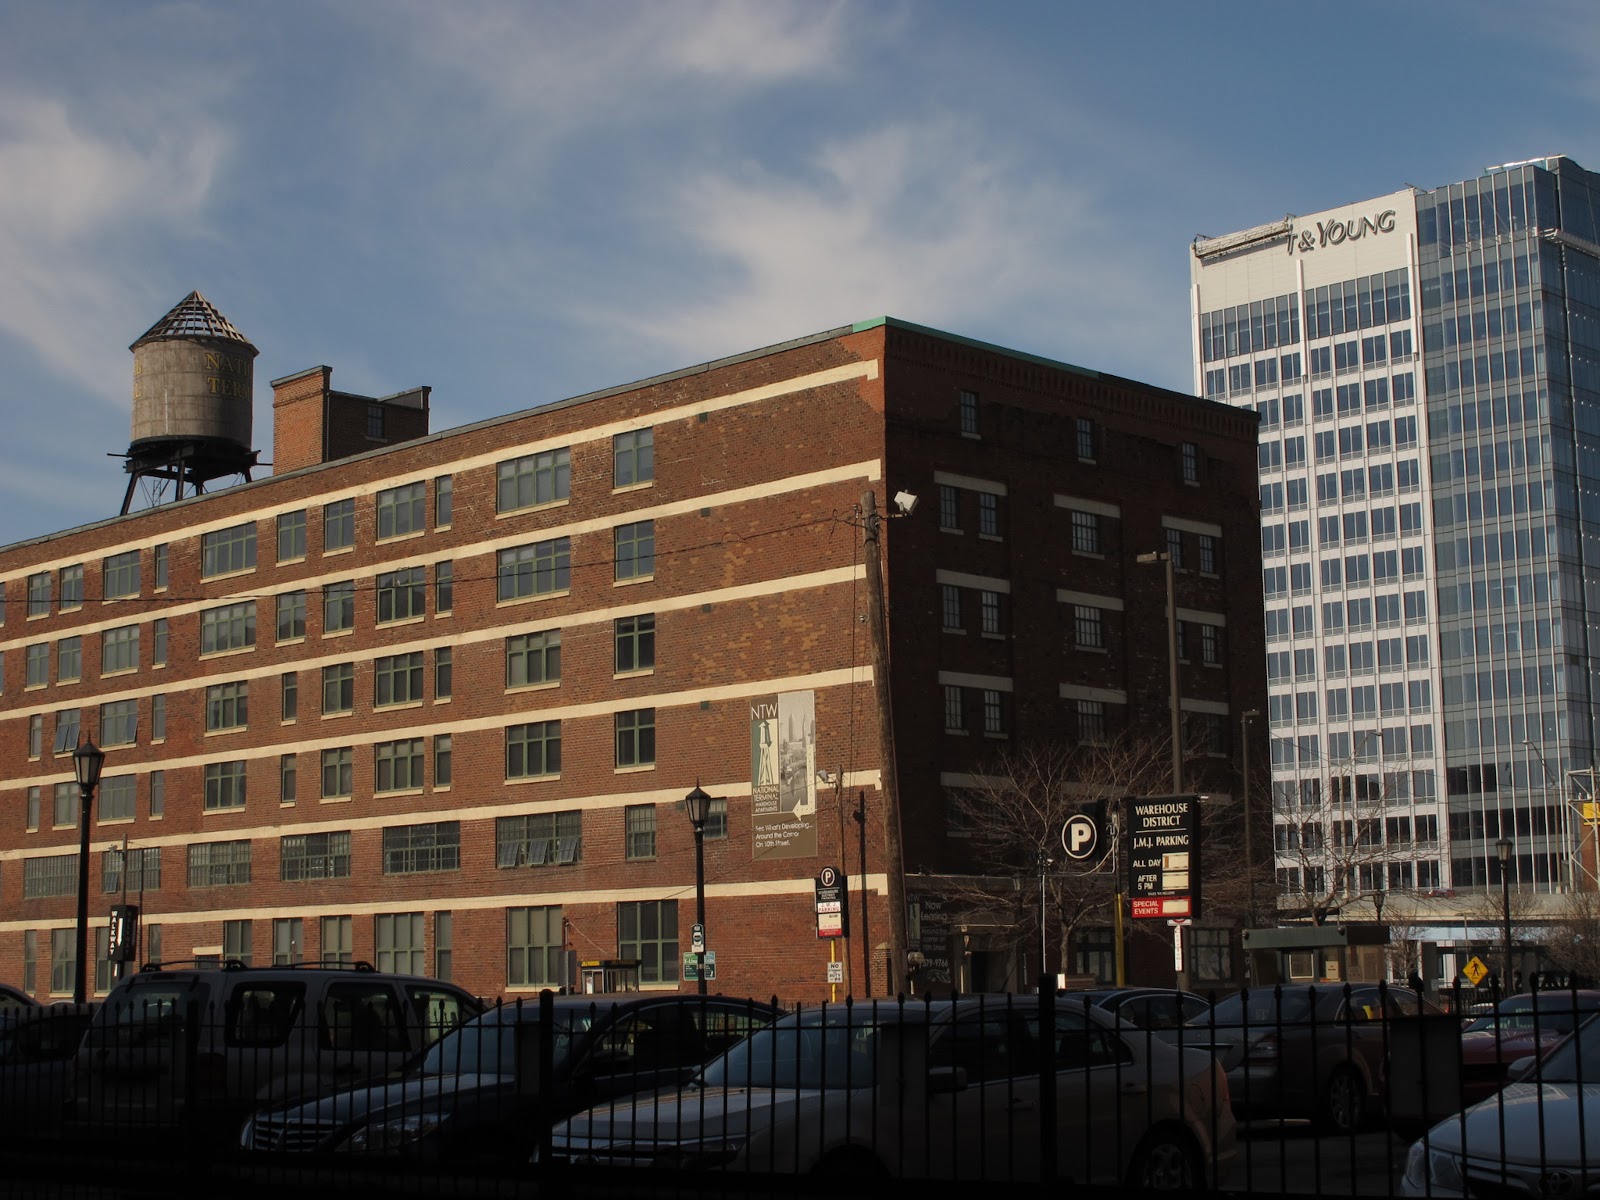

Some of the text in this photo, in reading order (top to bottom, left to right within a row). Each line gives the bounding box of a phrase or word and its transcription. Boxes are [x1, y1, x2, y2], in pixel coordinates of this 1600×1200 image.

[1316, 209, 1396, 248] YOUNG
[751, 702, 778, 720] NTW
[752, 785, 779, 795] NATIONAL
[753, 793, 779, 802] TERMINAL
[1134, 802, 1189, 816] WAREHOUSE
[1142, 815, 1181, 828] DISTRICT
[755, 832, 774, 840] Around
[1071, 823, 1091, 851] P
[1133, 834, 1189, 850] J.M.J. PARKING
[1132, 858, 1162, 868] ALL DAY
[1137, 874, 1157, 882] AFTER
[1144, 882, 1153, 890] PM
[925, 901, 942, 910] Now
[1133, 900, 1159, 908] SPECIAL
[1134, 907, 1159, 915] EVENTS
[110, 910, 119, 955] WALKWAY
